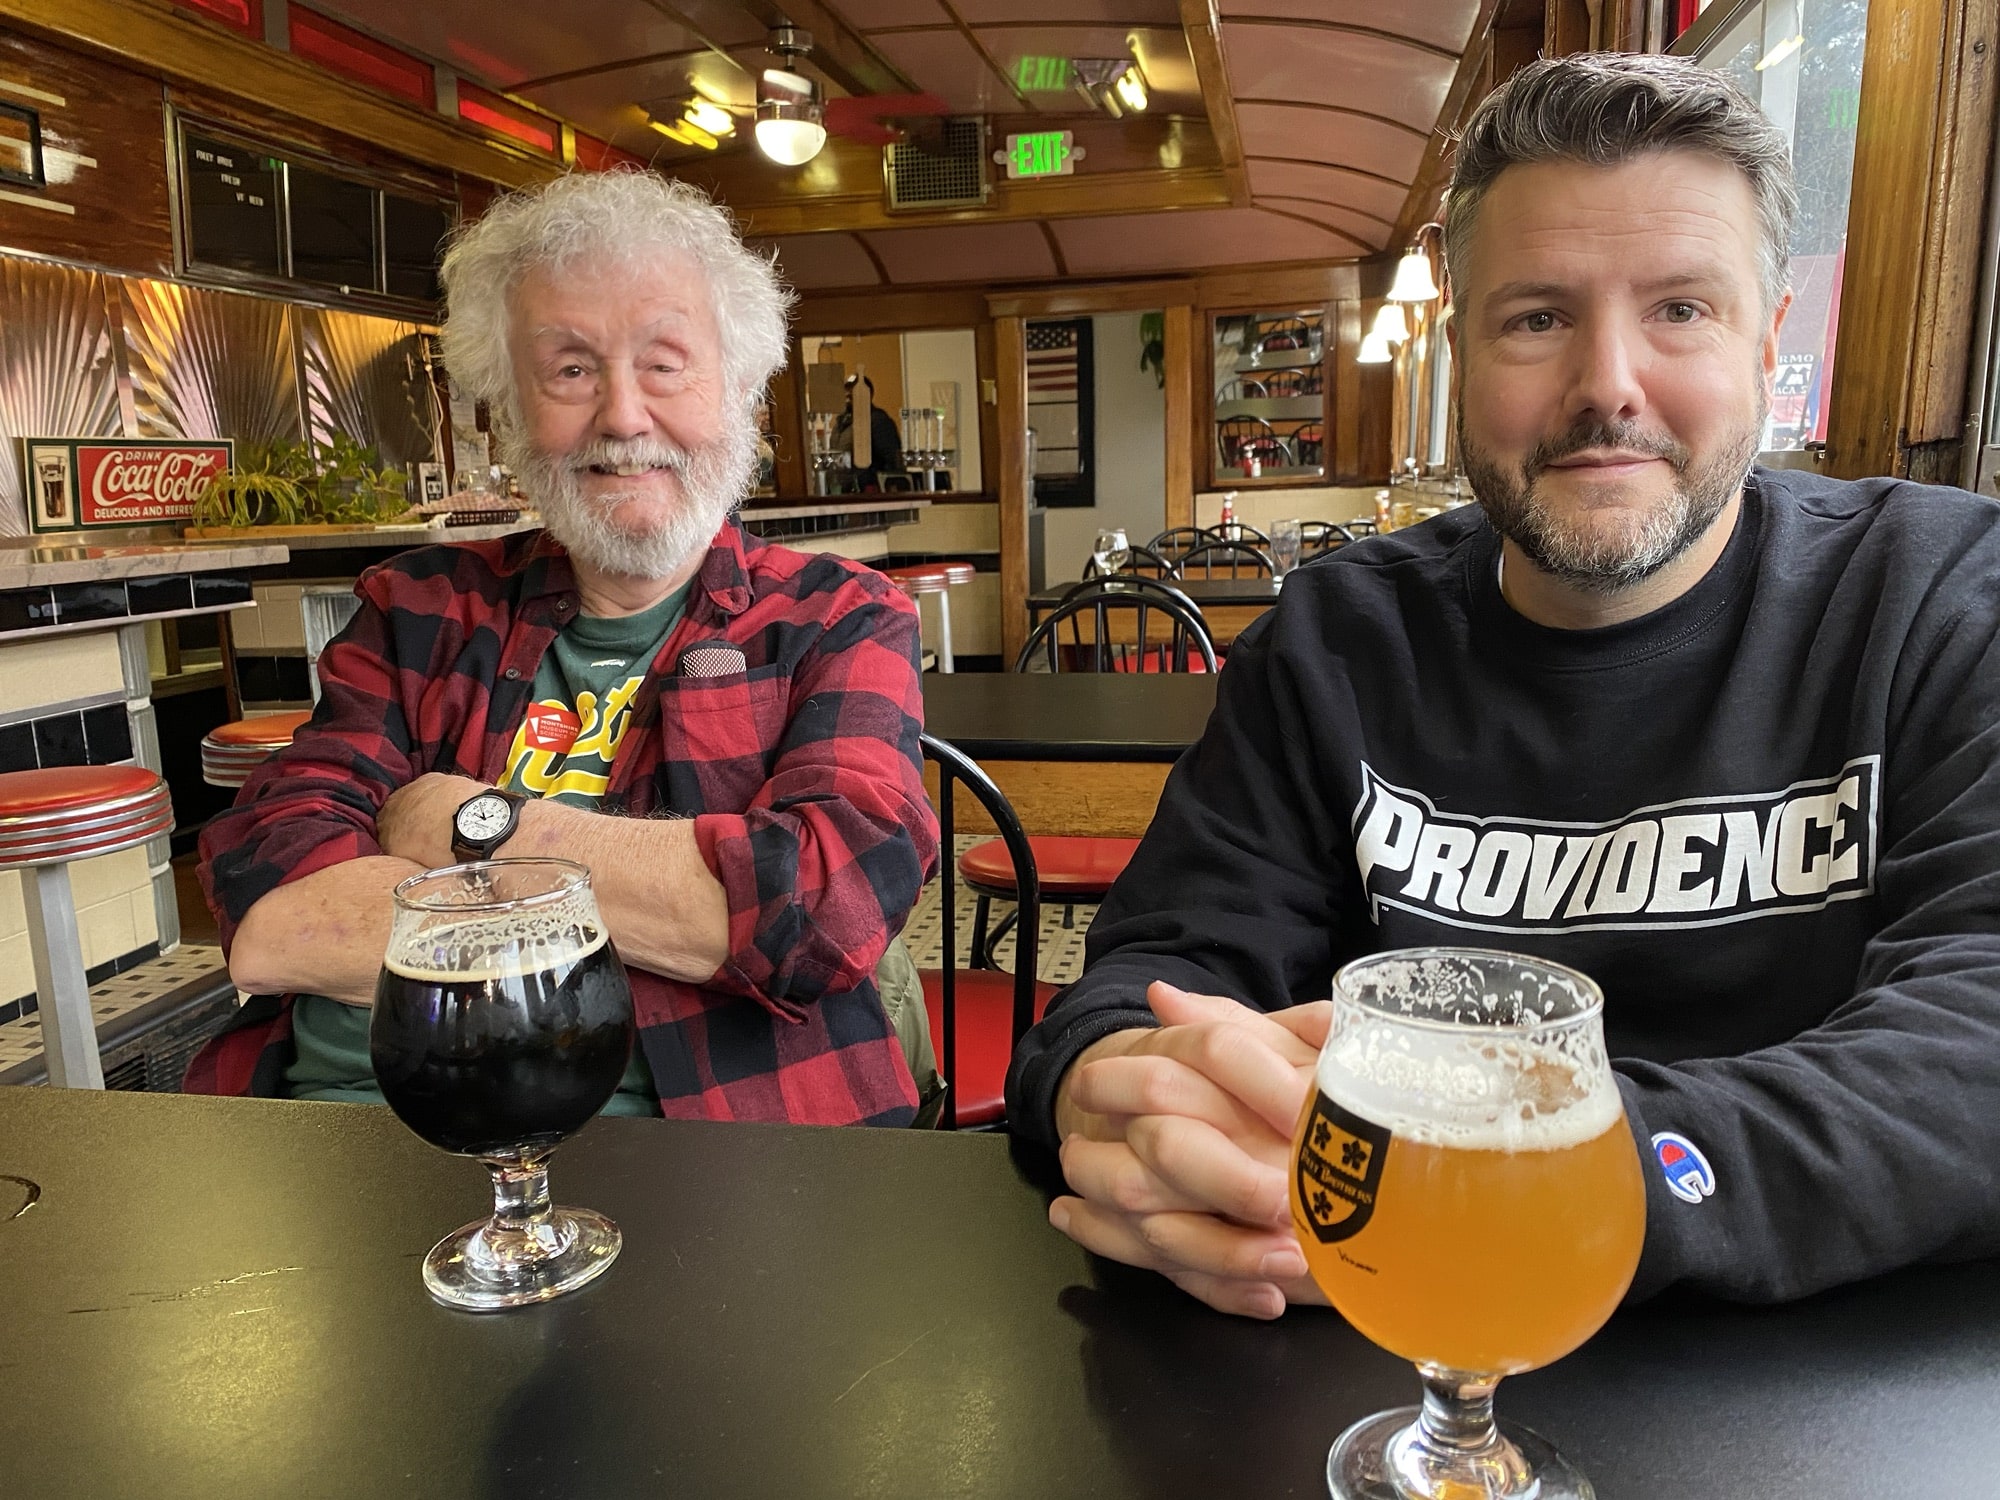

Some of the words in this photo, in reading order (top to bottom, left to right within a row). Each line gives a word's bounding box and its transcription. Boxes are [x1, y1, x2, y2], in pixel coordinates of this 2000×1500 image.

[1017, 131, 1065, 175] EXIT
[125, 451, 162, 461] DRINK
[92, 450, 215, 507] Coca-Cola
[94, 506, 140, 519] DELICIOUS
[142, 505, 162, 516] AND
[540, 730, 568, 739] SCIENCE
[1355, 776, 1859, 920] PROVIDENCE
